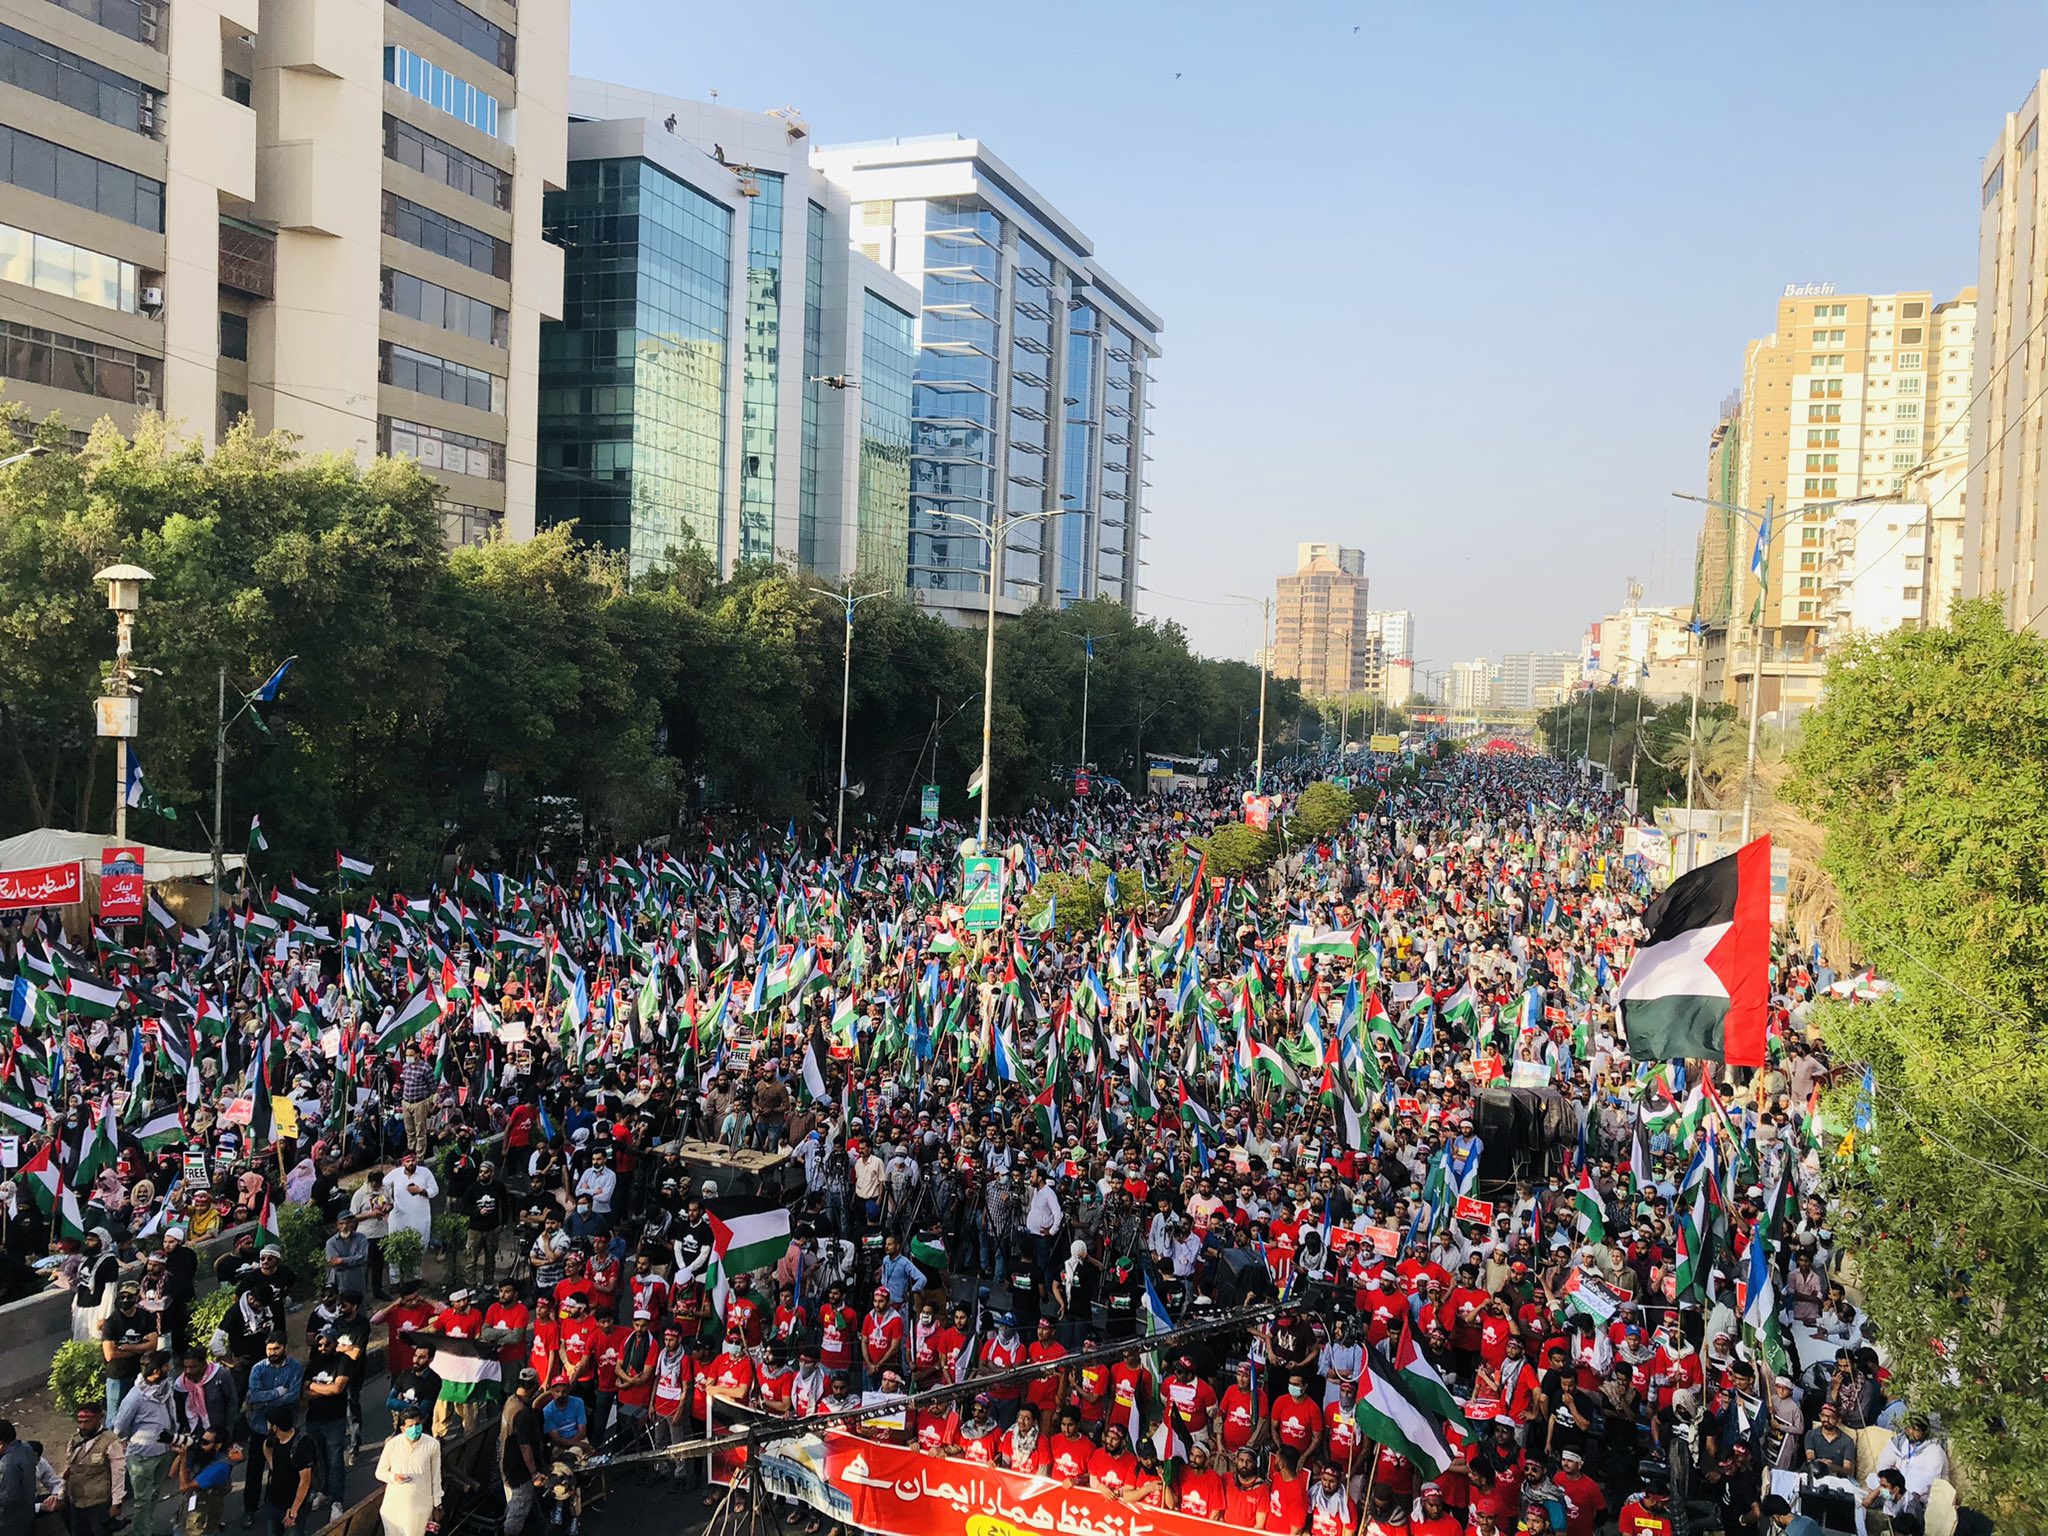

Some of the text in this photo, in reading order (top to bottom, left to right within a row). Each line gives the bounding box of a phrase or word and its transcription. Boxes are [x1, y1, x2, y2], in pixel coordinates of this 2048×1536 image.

[1783, 281, 1836, 297] Bakshi
[27, 870, 77, 899] فلسطین
[730, 1051, 750, 1061] FREE
[185, 1168, 206, 1179] FREE
